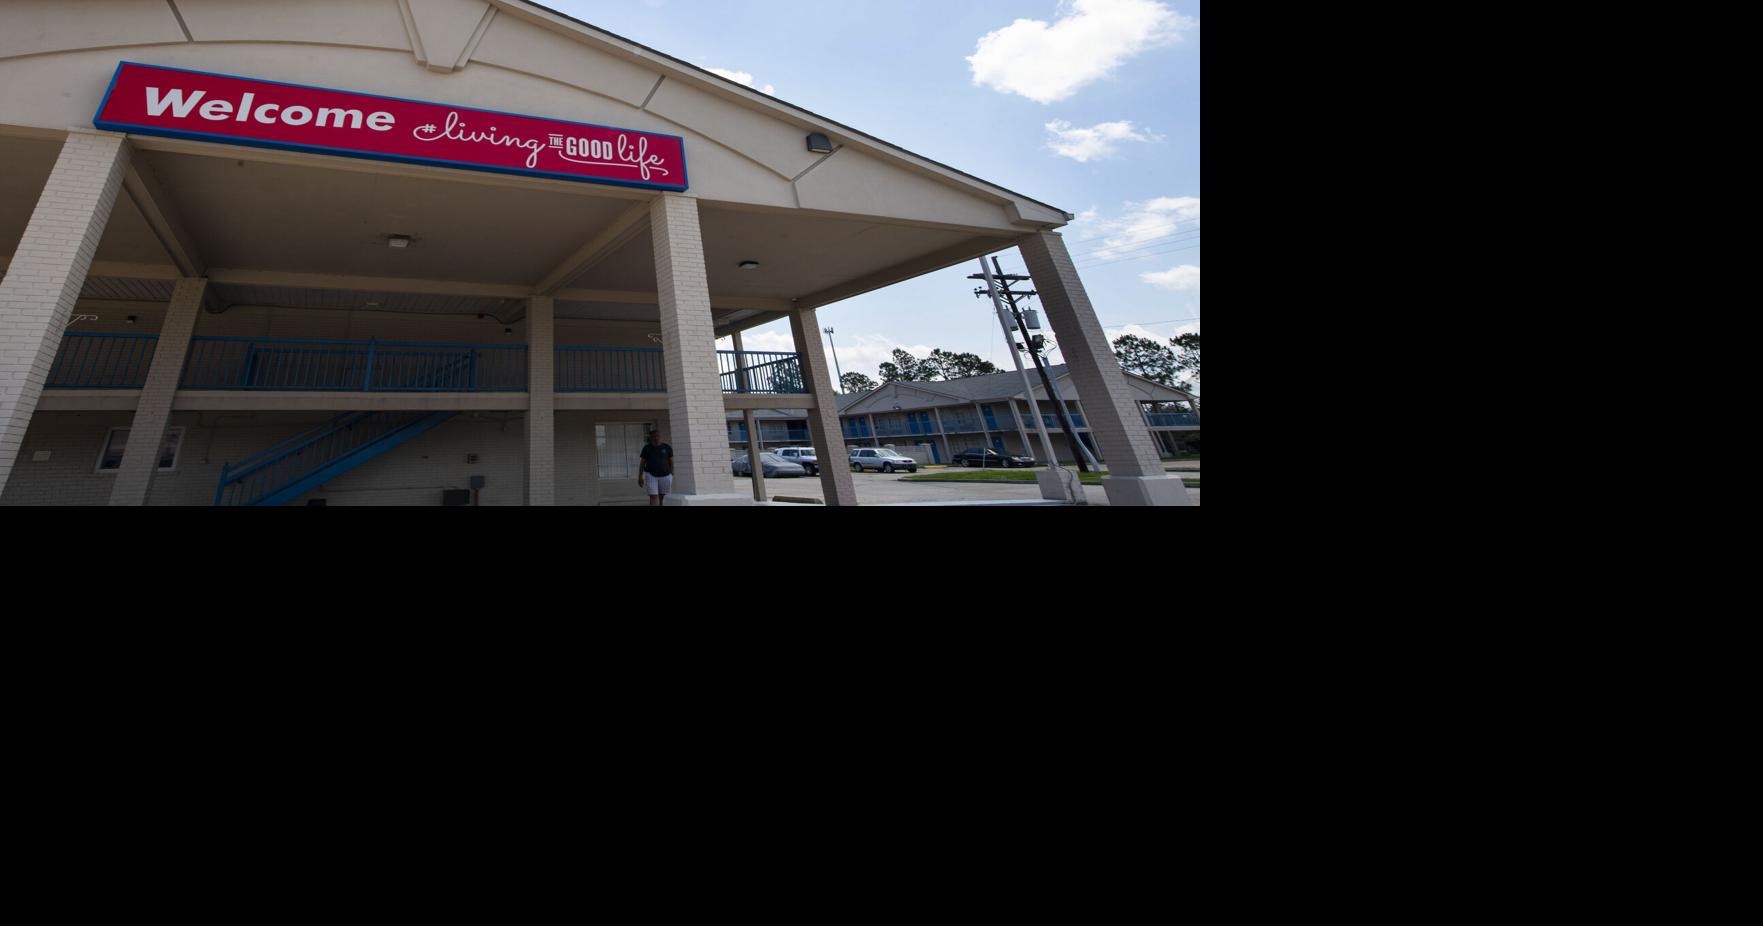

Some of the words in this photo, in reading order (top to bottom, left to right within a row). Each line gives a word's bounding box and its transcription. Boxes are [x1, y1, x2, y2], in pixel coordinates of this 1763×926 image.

[145, 86, 396, 132] Welcome
[413, 111, 546, 169] #living
[548, 136, 564, 146] THE
[565, 136, 613, 161] GOOD
[617, 133, 666, 181] life
